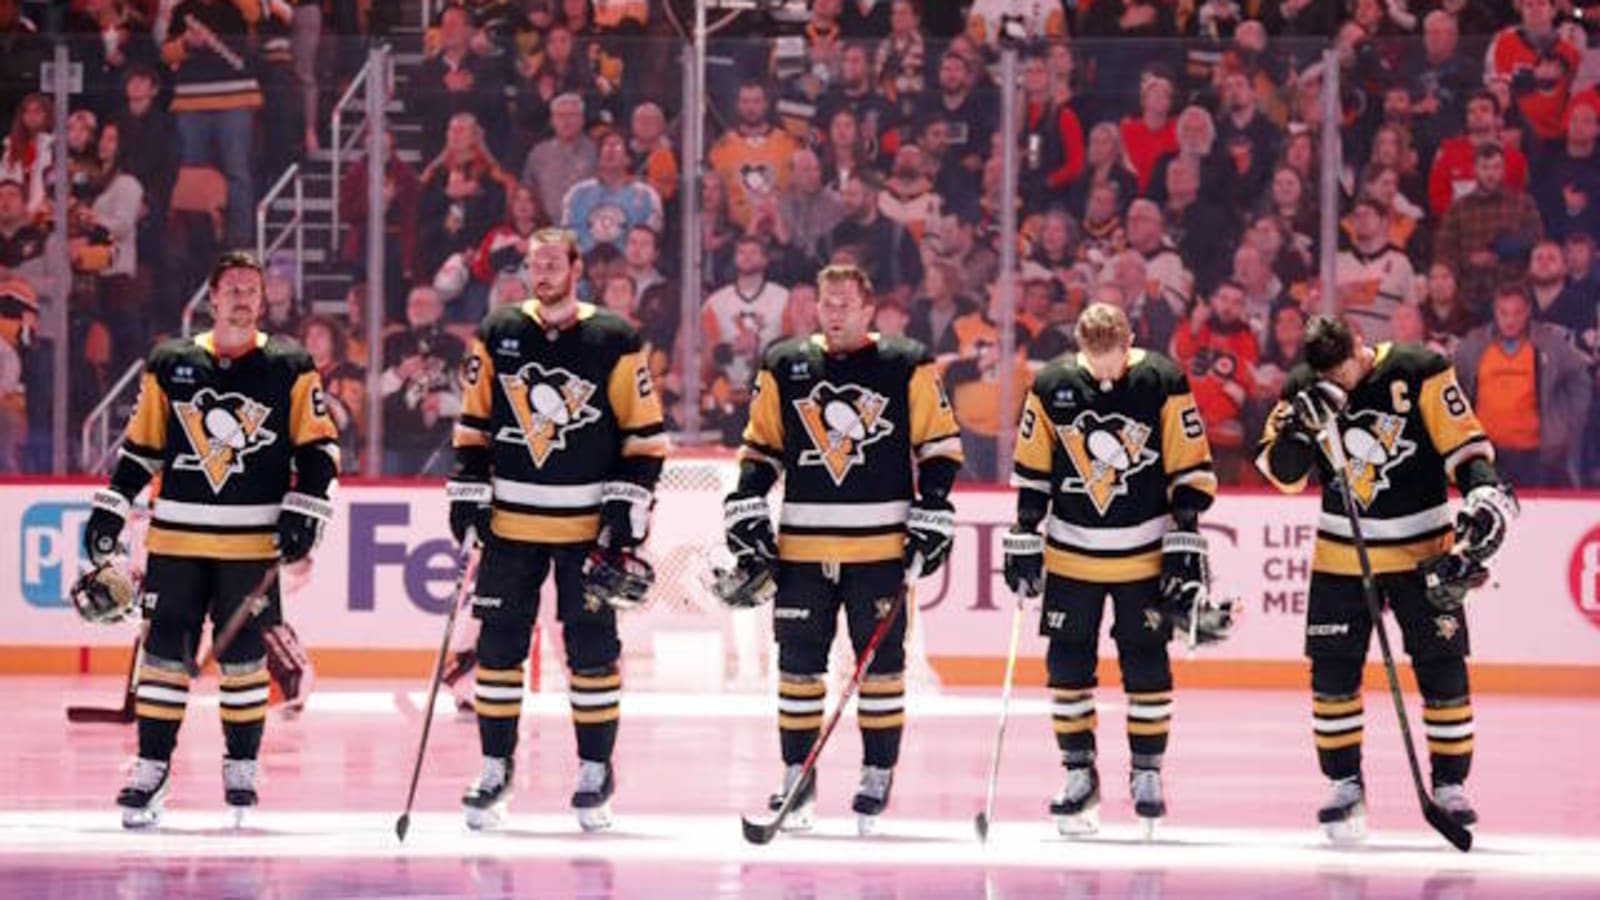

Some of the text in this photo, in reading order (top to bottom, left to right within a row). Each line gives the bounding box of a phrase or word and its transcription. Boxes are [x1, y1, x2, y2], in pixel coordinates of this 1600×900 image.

[1389, 379, 1412, 414] C
[1442, 385, 1467, 417] 8
[1181, 406, 1204, 438] 5
[1263, 525, 1312, 548] LIF
[1263, 557, 1308, 582] CH
